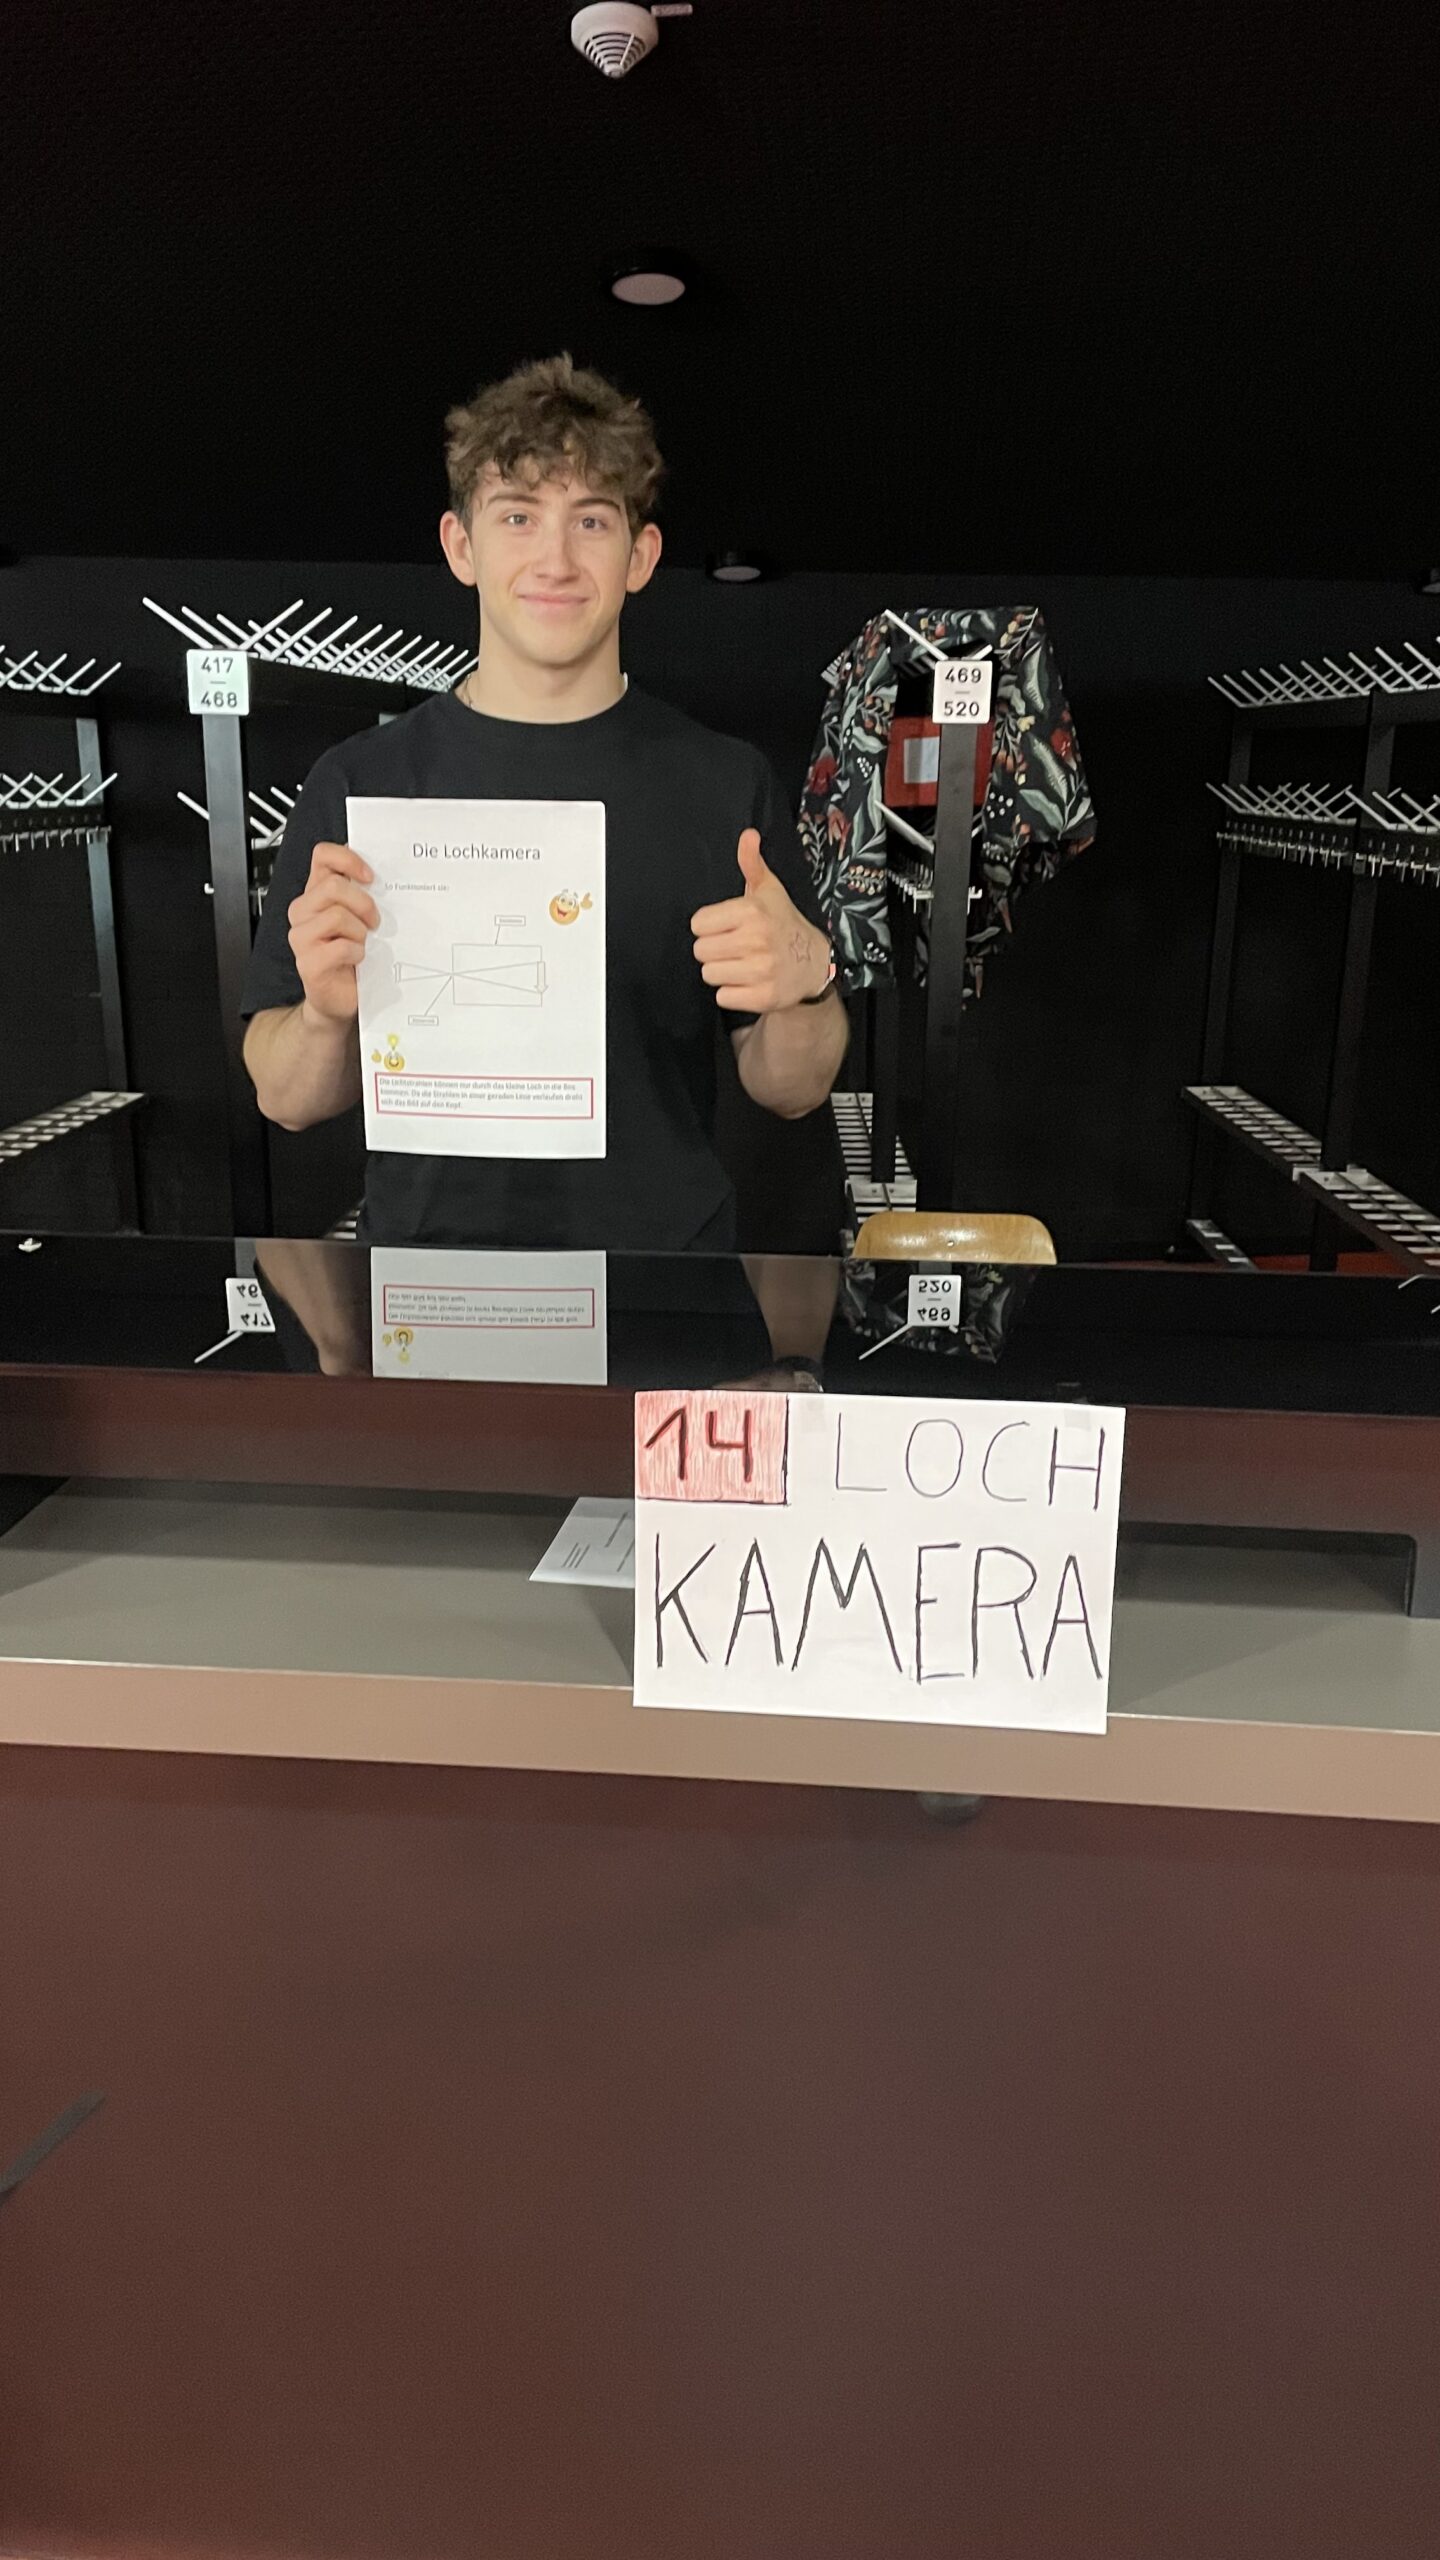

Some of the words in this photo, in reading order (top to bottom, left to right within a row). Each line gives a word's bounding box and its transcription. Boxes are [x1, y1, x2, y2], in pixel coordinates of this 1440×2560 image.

[200, 656, 234, 674] 417
[945, 667, 982, 683] 469
[200, 691, 238, 708] 468
[944, 700, 980, 717] 520
[412, 843, 438, 858] Die
[444, 844, 541, 860] Lochkamera
[644, 1405, 753, 1482] 14
[834, 1411, 1106, 1512] LOCH
[654, 1532, 1104, 1685] KAMERA
